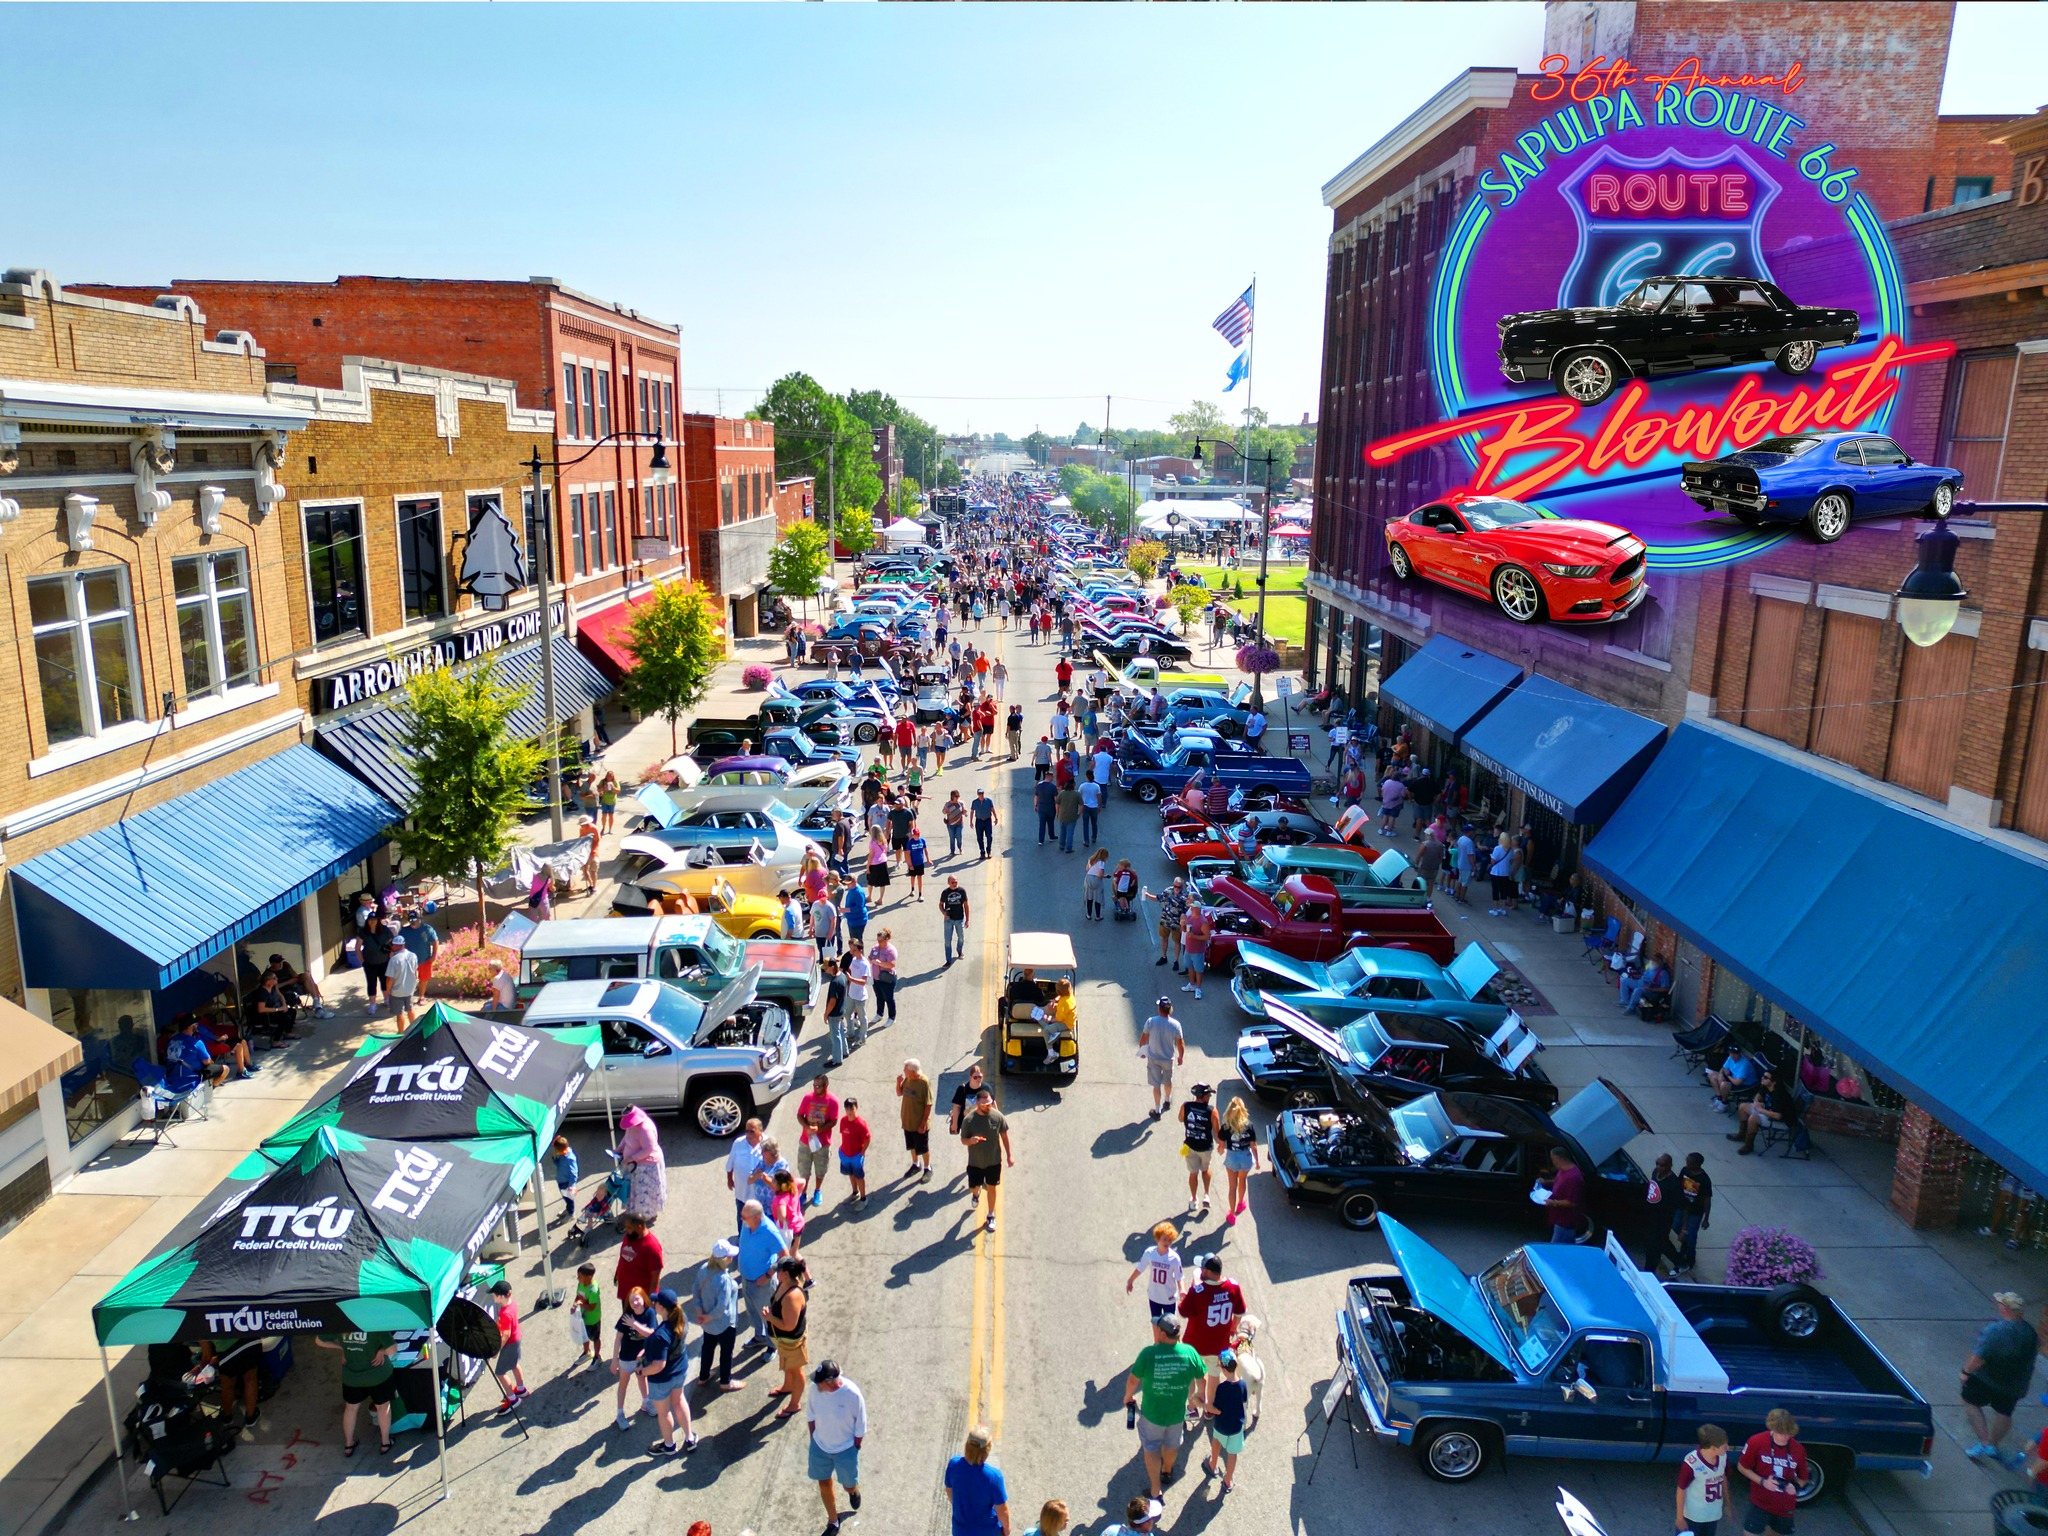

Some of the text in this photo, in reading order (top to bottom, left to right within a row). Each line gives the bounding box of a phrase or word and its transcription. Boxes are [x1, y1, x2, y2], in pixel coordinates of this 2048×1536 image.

[332, 602, 566, 710] ARROWHEAD LAND COMPNY
[1467, 746, 1503, 778] ABSTRACTS
[1522, 779, 1564, 815] INSURANCE
[476, 1025, 529, 1076] TTCU
[374, 1056, 470, 1093] TTCU
[369, 1091, 463, 1104] Federal Credit Union
[371, 1145, 440, 1215] TTCU
[240, 1196, 355, 1239] TTCU
[232, 1239, 344, 1251] Federal Credit Union
[1152, 1268, 1168, 1286] 10
[205, 1305, 264, 1333] TTCU
[264, 1309, 298, 1321] Federal
[265, 1318, 323, 1331] Credit Union
[1206, 1301, 1233, 1328] 50
